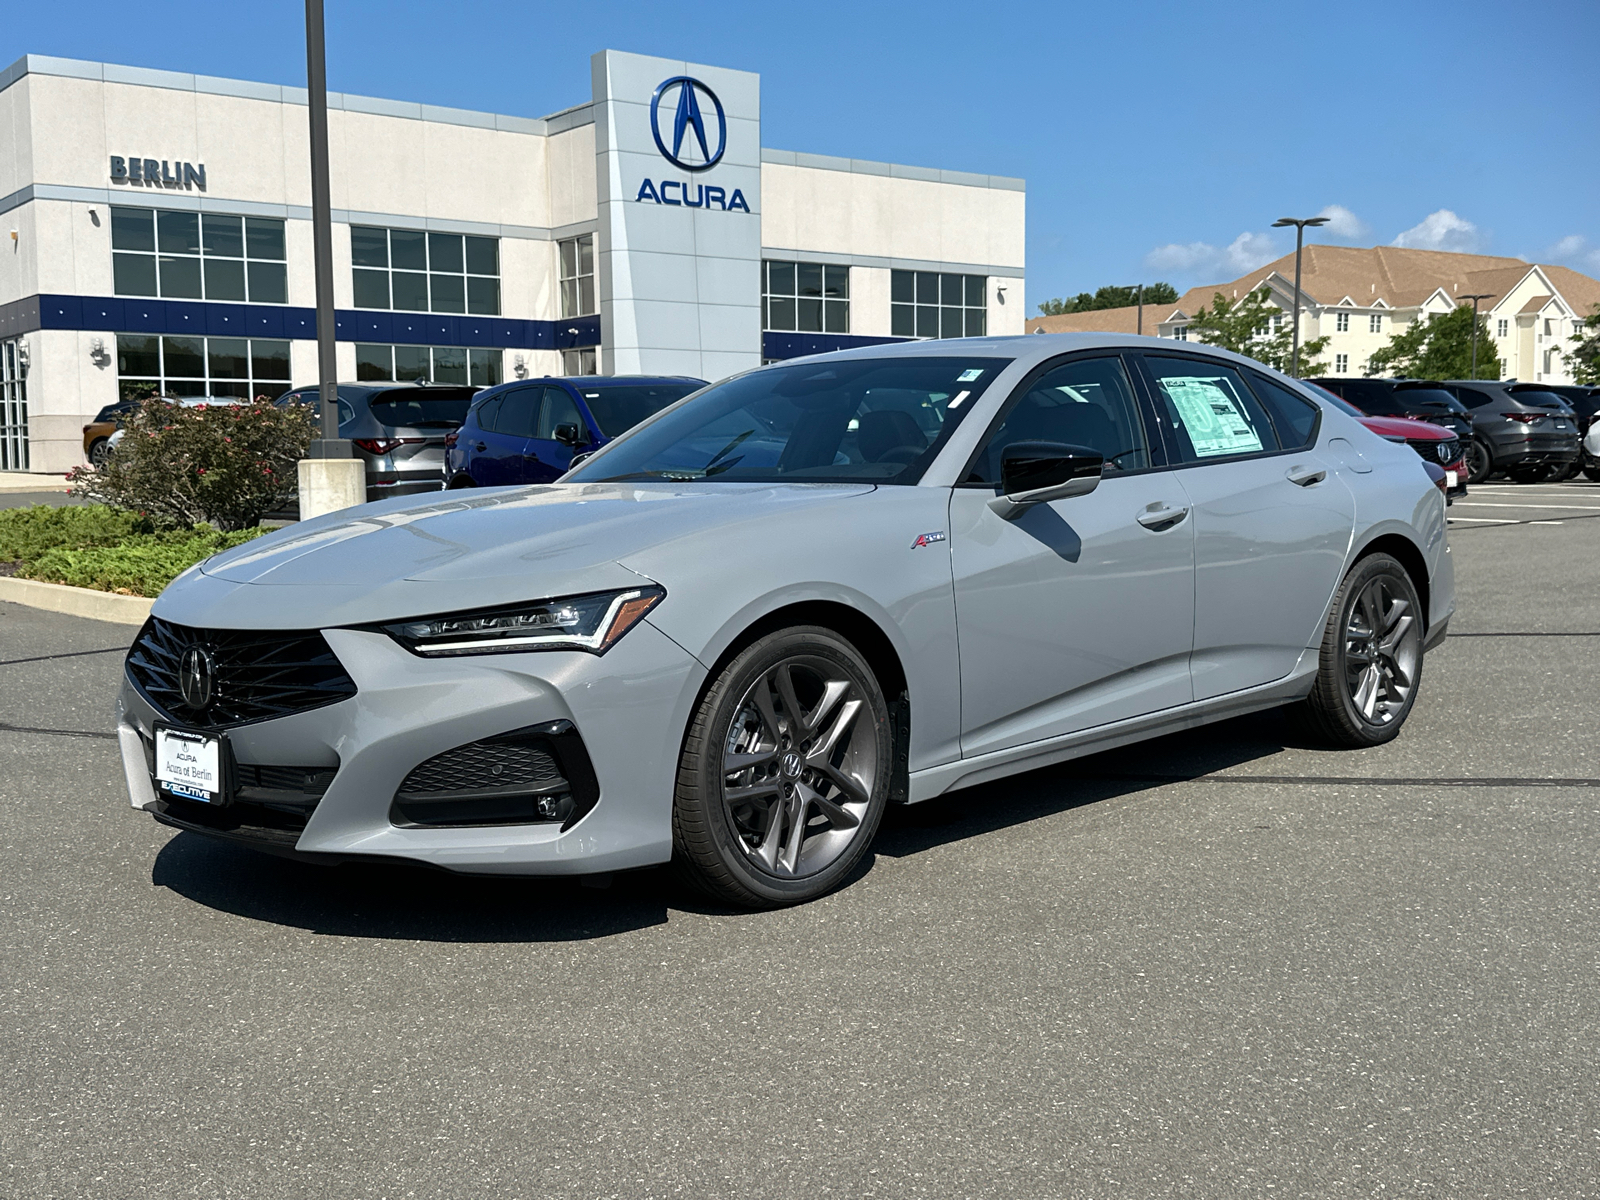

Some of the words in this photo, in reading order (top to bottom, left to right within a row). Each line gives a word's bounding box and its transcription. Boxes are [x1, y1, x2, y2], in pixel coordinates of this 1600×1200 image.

[110, 155, 206, 187] BERLIN
[635, 178, 751, 213] ACURA
[177, 753, 197, 763] ACURA
[166, 761, 182, 775] Acura
[183, 766, 190, 777] of
[191, 766, 212, 781] Berlin
[161, 781, 211, 800] EXECUTIVE
